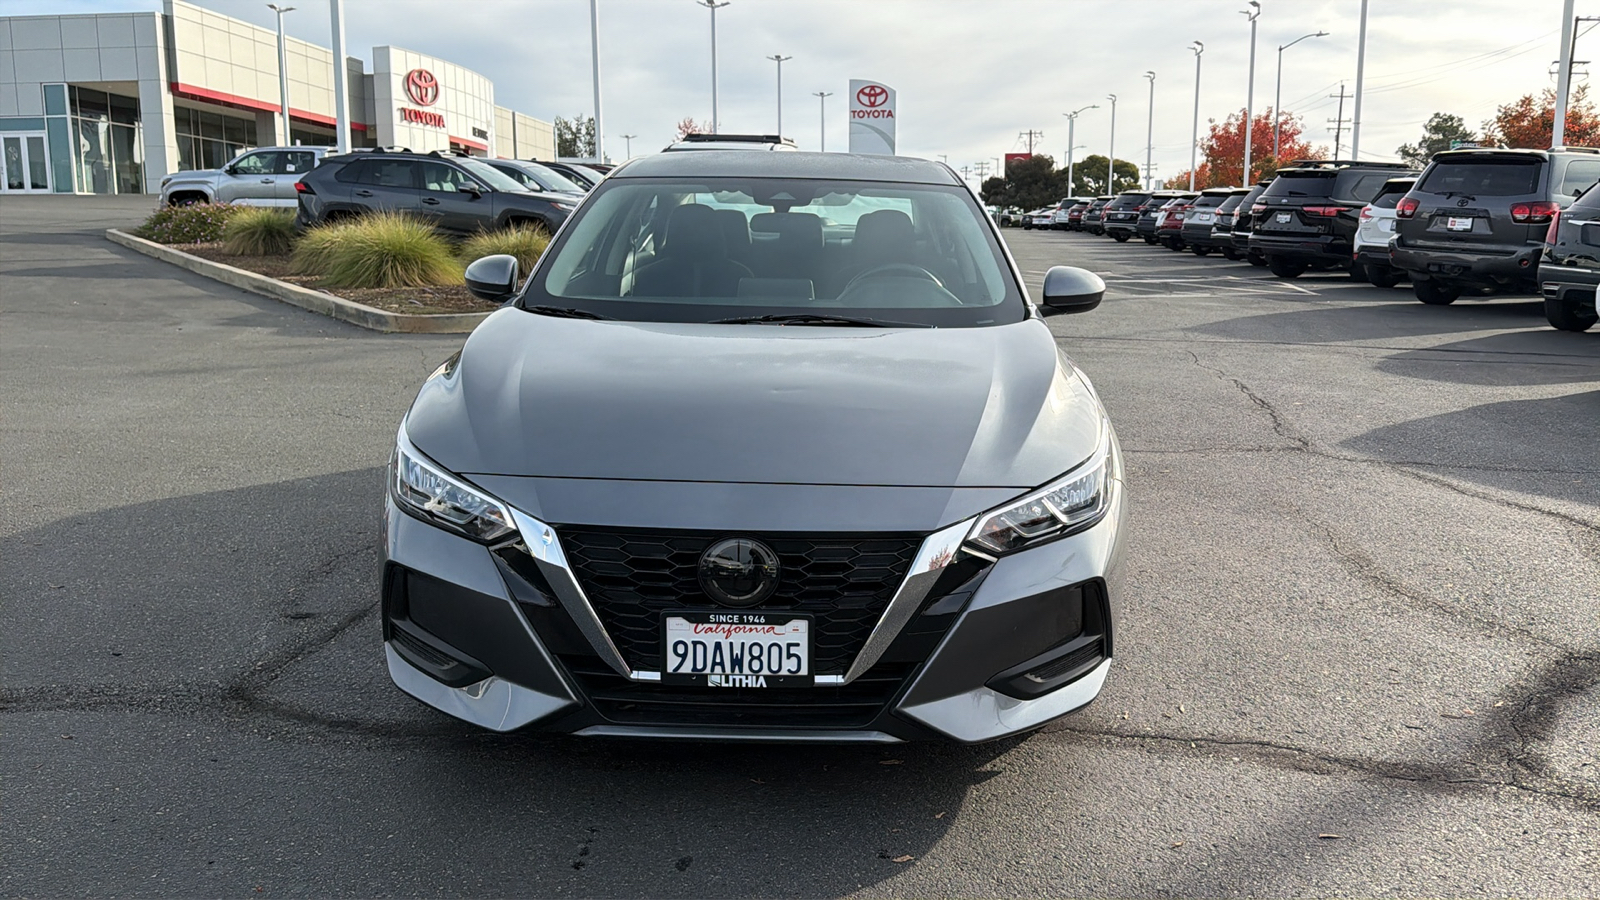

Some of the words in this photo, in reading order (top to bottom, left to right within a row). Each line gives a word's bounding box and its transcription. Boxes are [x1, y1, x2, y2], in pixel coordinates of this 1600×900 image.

[401, 107, 446, 129] TOYOTA
[850, 109, 895, 119] TOYOTA
[709, 614, 740, 623] SINCE
[742, 615, 766, 624] 1946
[693, 623, 786, 640] California
[672, 639, 802, 674] 9DAW805
[721, 675, 767, 688] LITHIA
